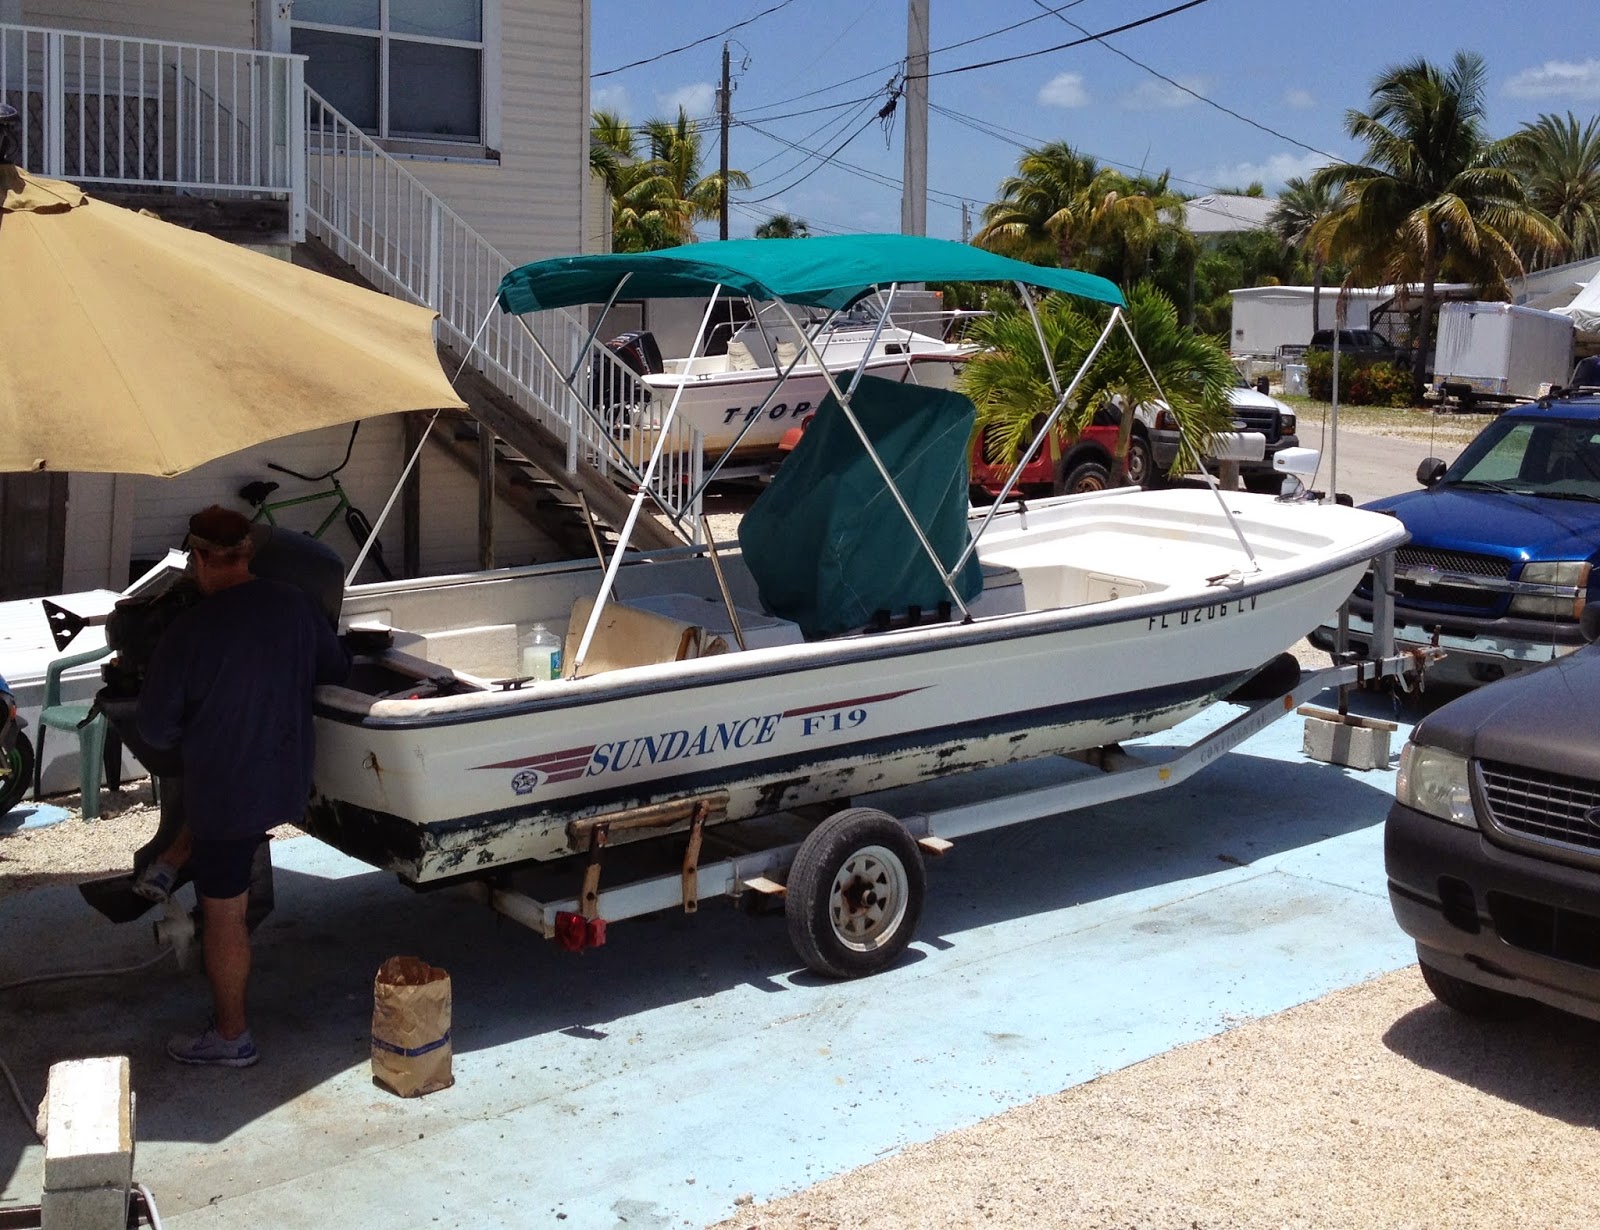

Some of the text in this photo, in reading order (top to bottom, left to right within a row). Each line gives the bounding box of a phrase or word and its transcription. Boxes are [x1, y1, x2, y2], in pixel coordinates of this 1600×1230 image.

[1149, 615, 1168, 631] FL
[1181, 604, 1227, 625] 0206
[586, 708, 868, 778] SUNDANCE F19
